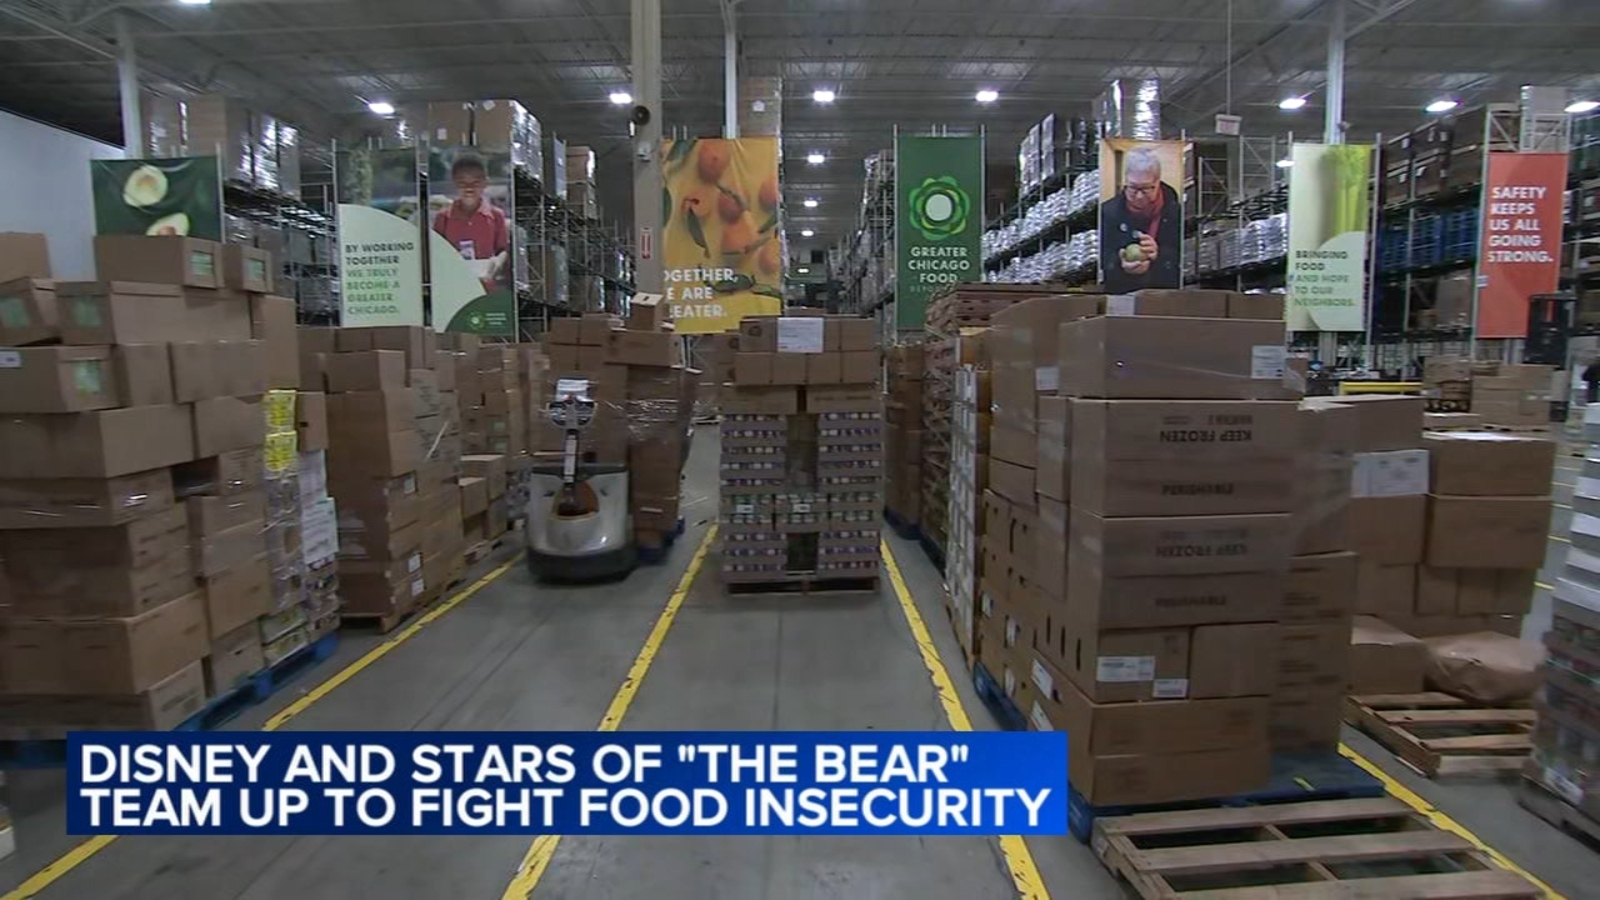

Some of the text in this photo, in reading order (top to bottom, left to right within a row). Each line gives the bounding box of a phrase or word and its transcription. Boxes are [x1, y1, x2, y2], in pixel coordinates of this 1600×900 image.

[1491, 187, 1546, 199] SAFETY
[1490, 203, 1535, 215] KEEPS
[1489, 219, 1541, 231] US ALL
[1489, 235, 1541, 247] GOING
[345, 242, 414, 253] BY WORKING
[910, 246, 968, 257] GREATER
[345, 255, 399, 265] TOGETHER
[1488, 251, 1554, 262] STRONG.
[907, 260, 971, 271] CHICAGO
[1295, 262, 1325, 271] FOOD
[664, 268, 739, 282] OGETHER,
[919, 273, 958, 283] FOOD
[666, 287, 714, 300] E ARE
[669, 304, 728, 318] EATER.
[1159, 430, 1252, 443] KEEP FROZEN
